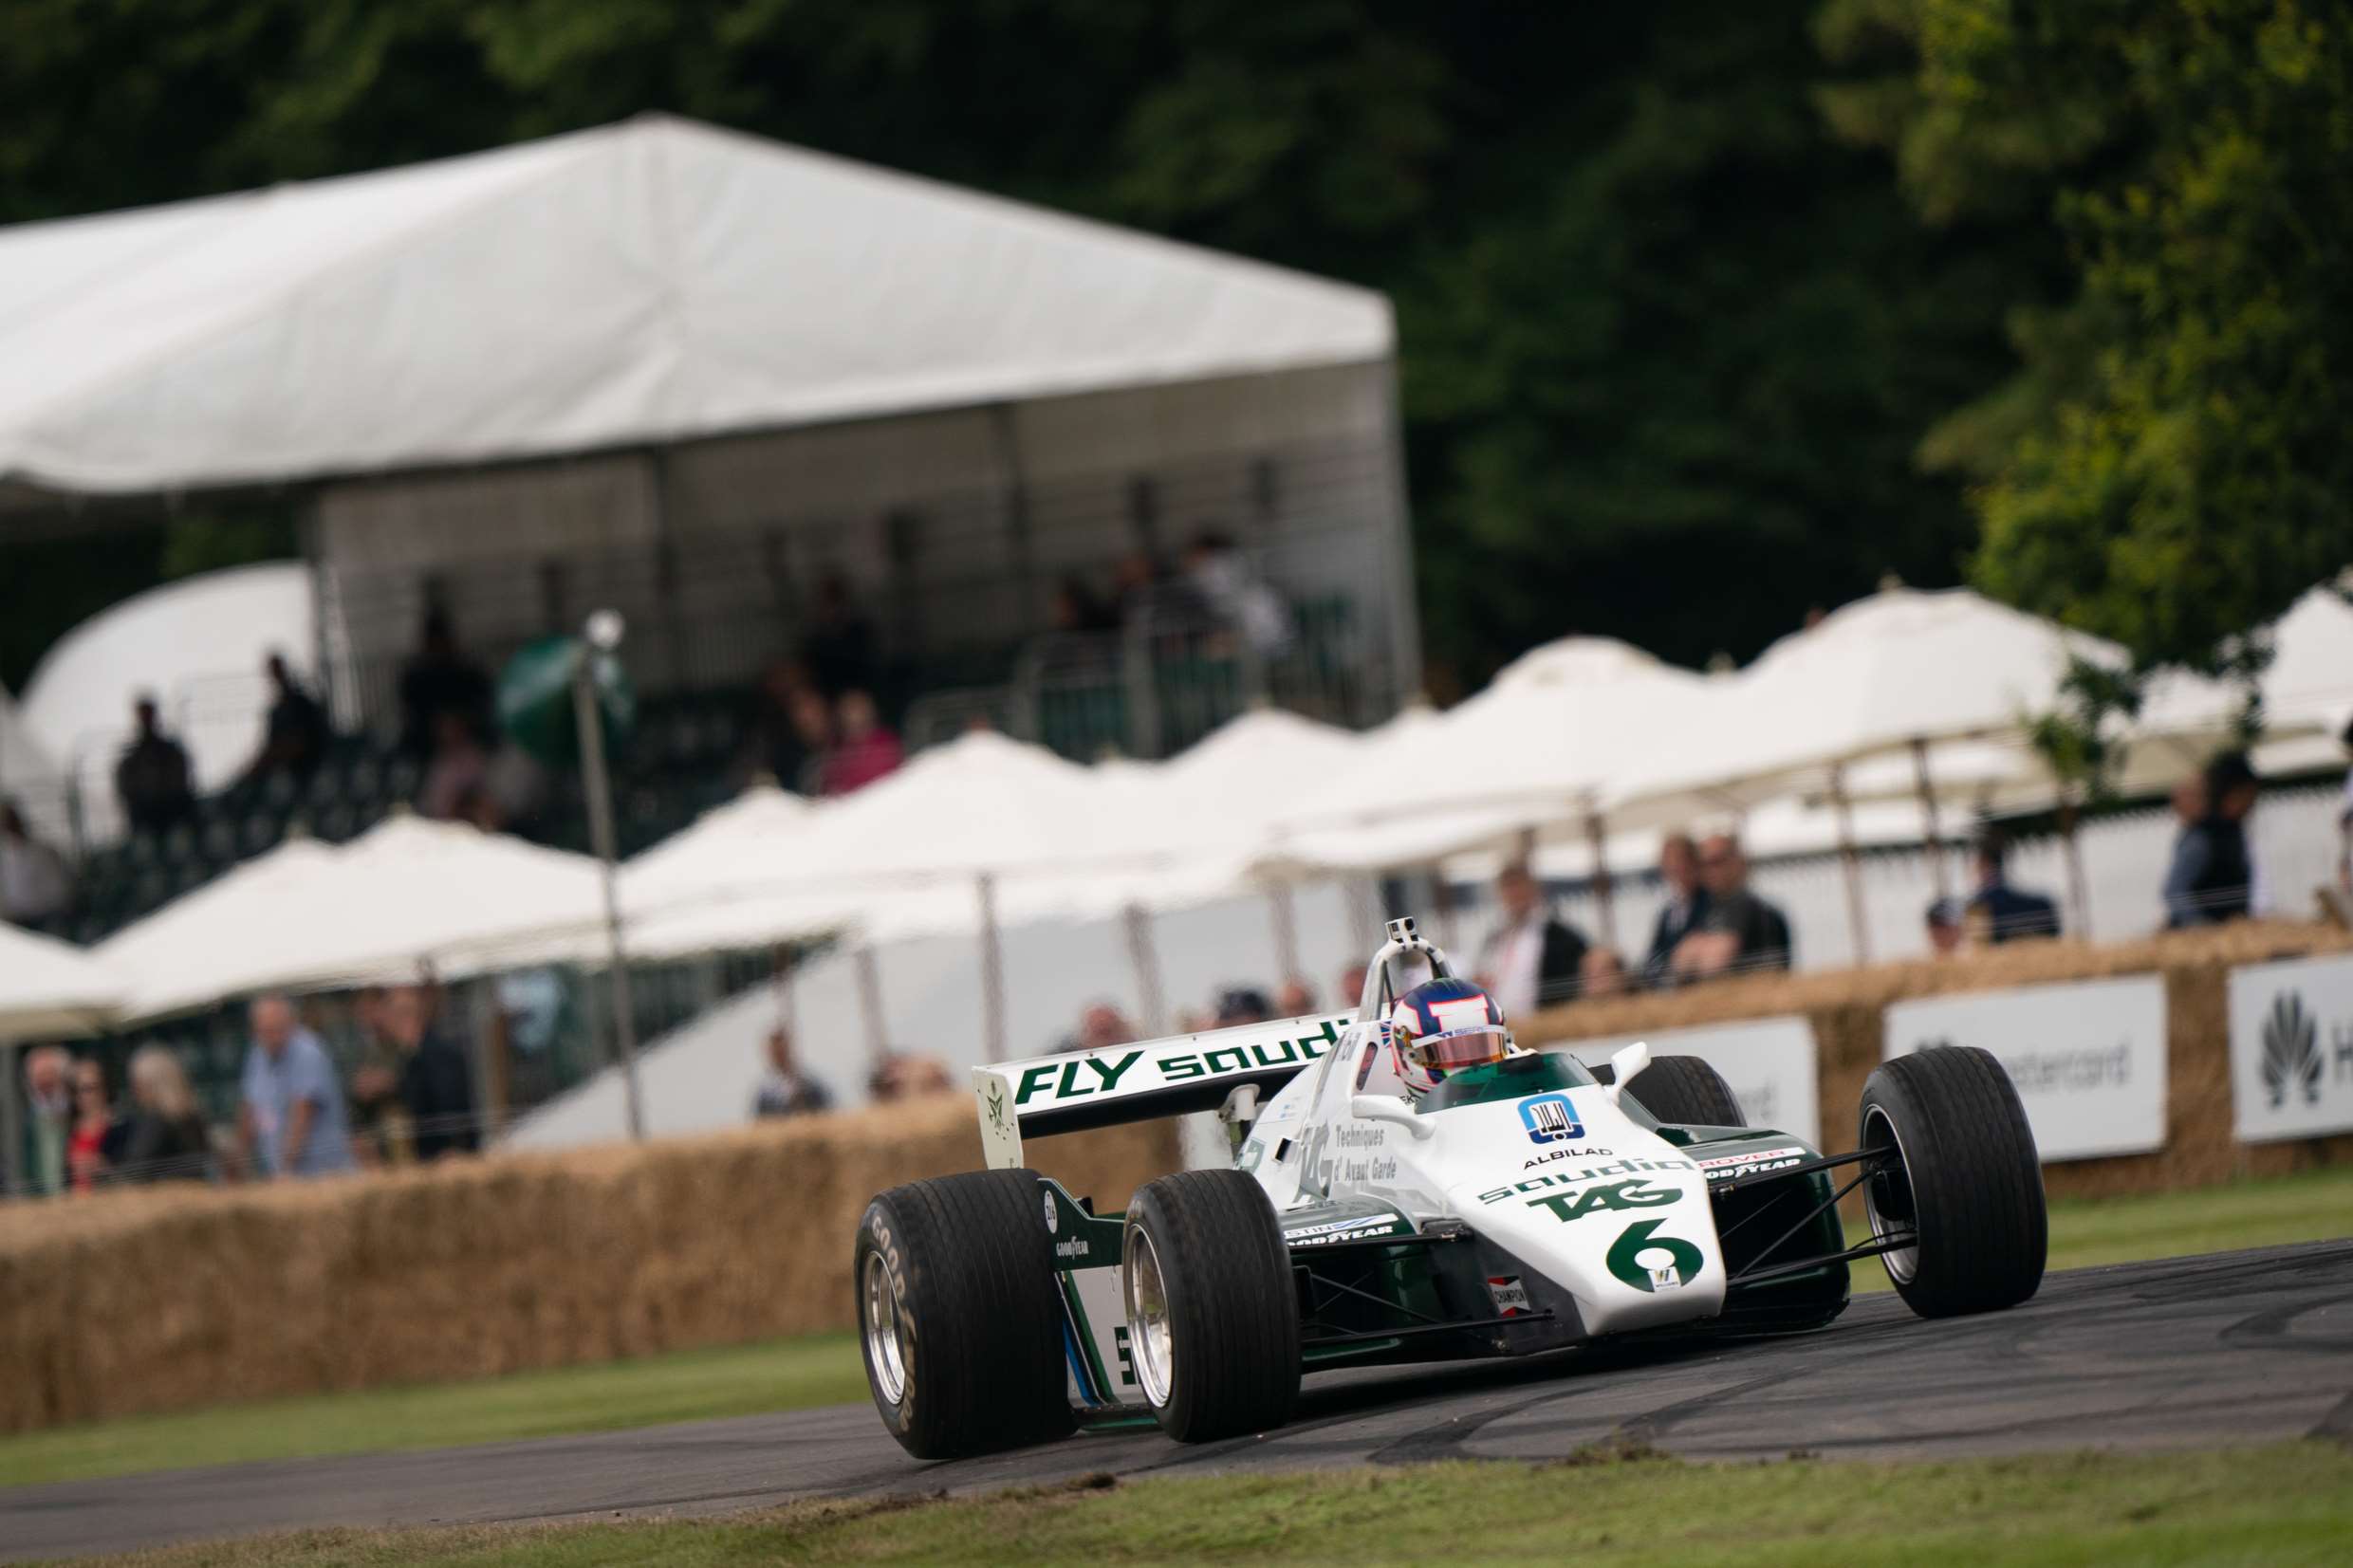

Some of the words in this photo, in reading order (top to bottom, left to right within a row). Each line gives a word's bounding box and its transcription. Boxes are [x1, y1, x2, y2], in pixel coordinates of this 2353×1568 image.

[1015, 1050, 1145, 1105] FLY
[1157, 1019, 1350, 1080] saud
[1336, 1124, 1384, 1151] Techniques
[1372, 1156, 1397, 1180] Garde
[1524, 1147, 1614, 1170] ALBILAD
[1698, 1149, 1787, 1169] ROVER
[1705, 1157, 1802, 1178] ODYEAR
[1479, 1158, 1695, 1205] saudia
[1526, 1179, 1683, 1223] TAG
[1056, 1235, 1089, 1261] GOODYEAR
[1605, 1217, 1704, 1293] 6
